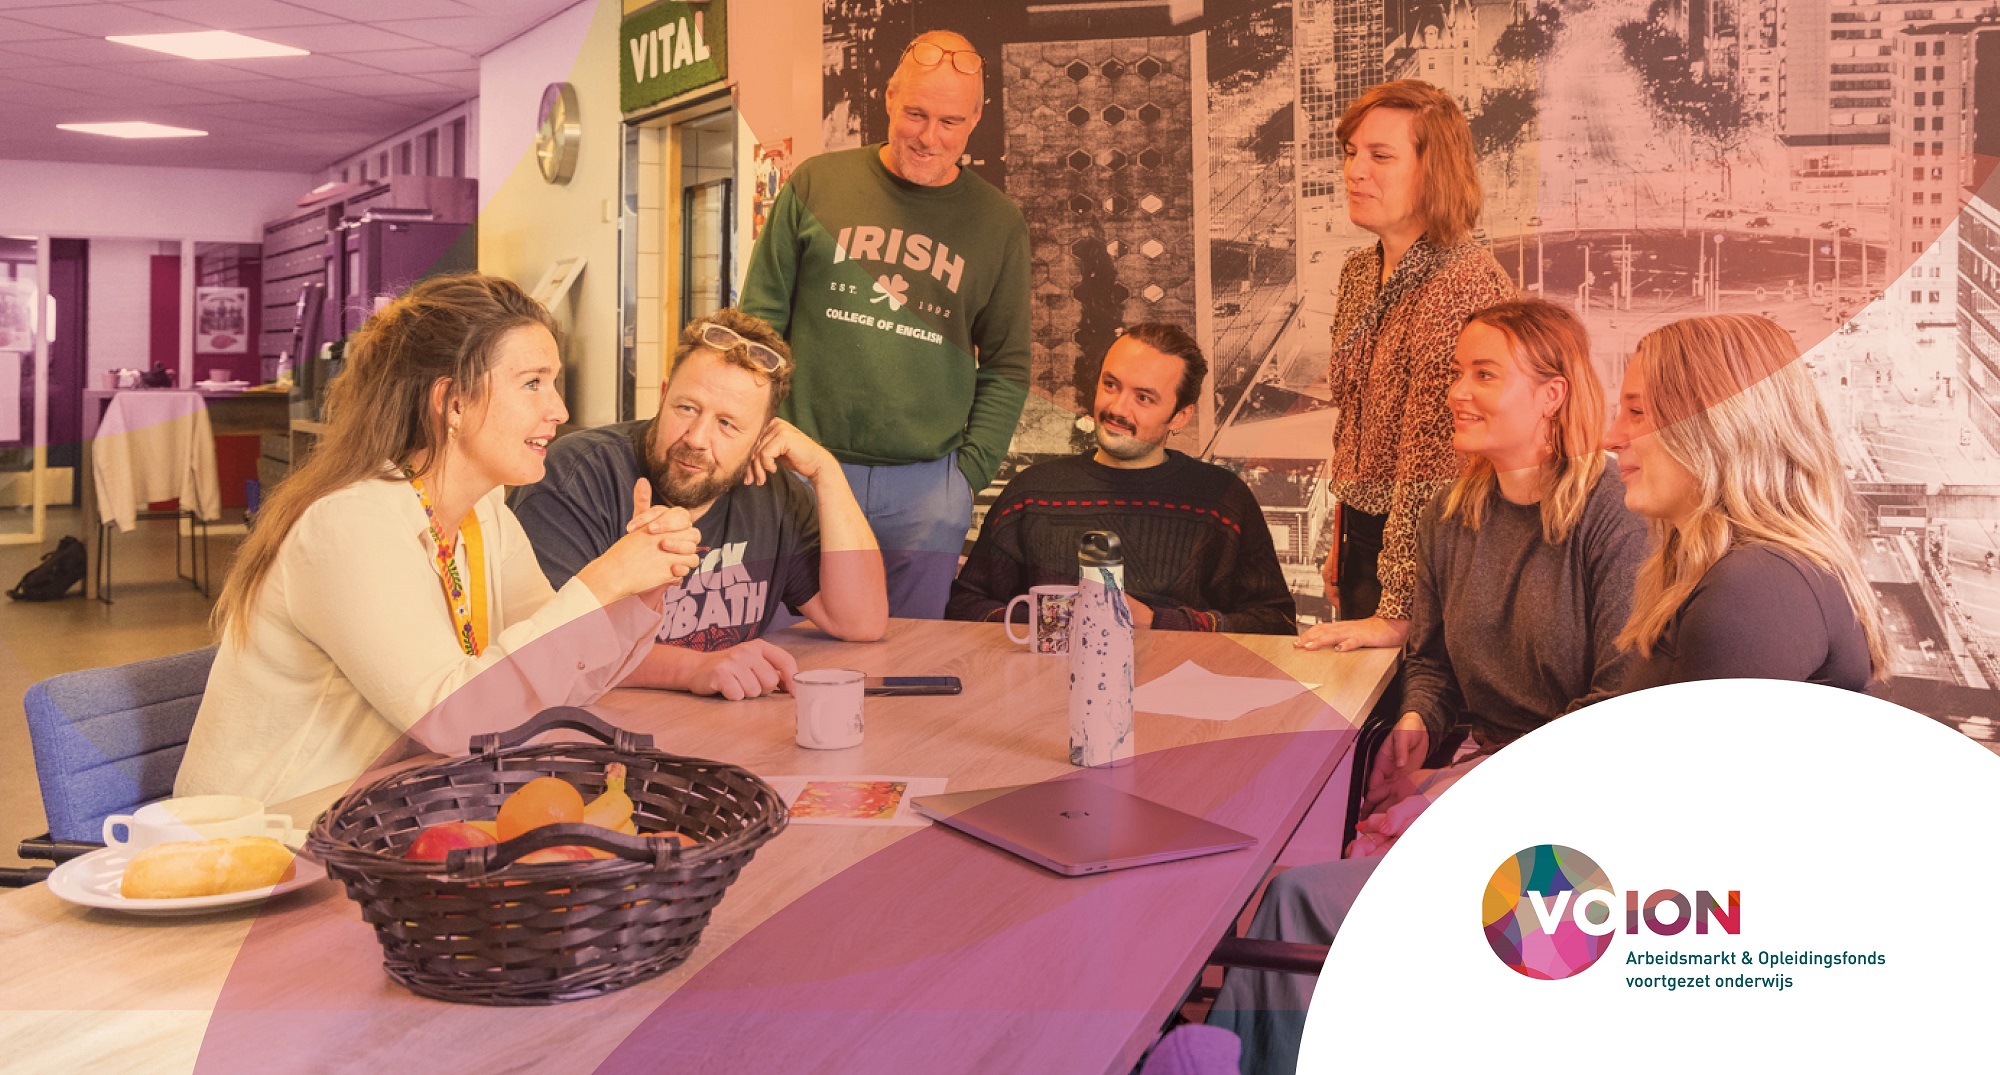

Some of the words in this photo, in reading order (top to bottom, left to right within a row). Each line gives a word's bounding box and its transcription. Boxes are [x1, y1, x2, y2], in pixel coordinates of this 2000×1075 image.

[629, 10, 711, 84] VITAL
[833, 225, 965, 294] IRISH
[825, 308, 875, 327] COLLEGE
[876, 319, 894, 331] OF
[895, 324, 943, 345] ENGLISH
